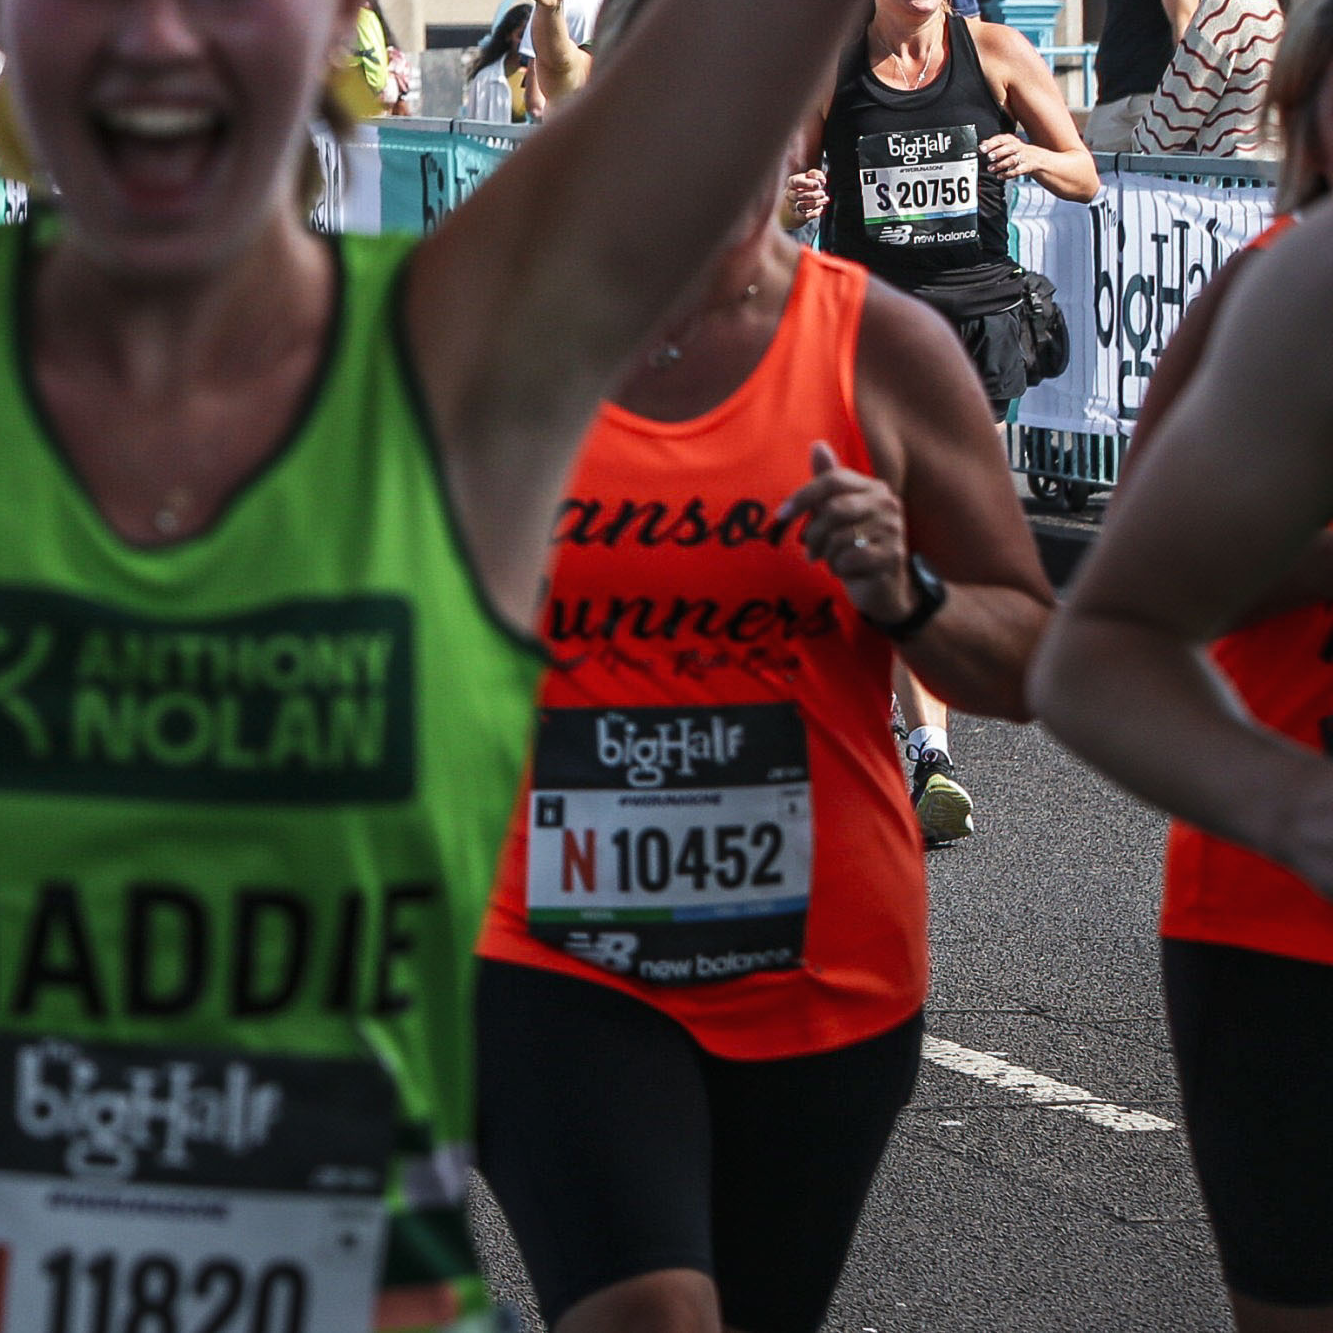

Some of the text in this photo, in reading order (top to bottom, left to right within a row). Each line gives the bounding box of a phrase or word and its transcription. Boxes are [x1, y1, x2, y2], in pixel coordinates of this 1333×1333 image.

[887, 132, 951, 165] bigHalf
[875, 176, 970, 211] S 20756
[78, 629, 393, 693] ANTHONY
[73, 689, 387, 767] NOLAN
[596, 716, 744, 787] bigHalf
[561, 821, 783, 893] N 10452
[638, 958, 694, 980] new
[15, 1043, 281, 1181] bigHalf
[41, 1247, 309, 1333] 11820
